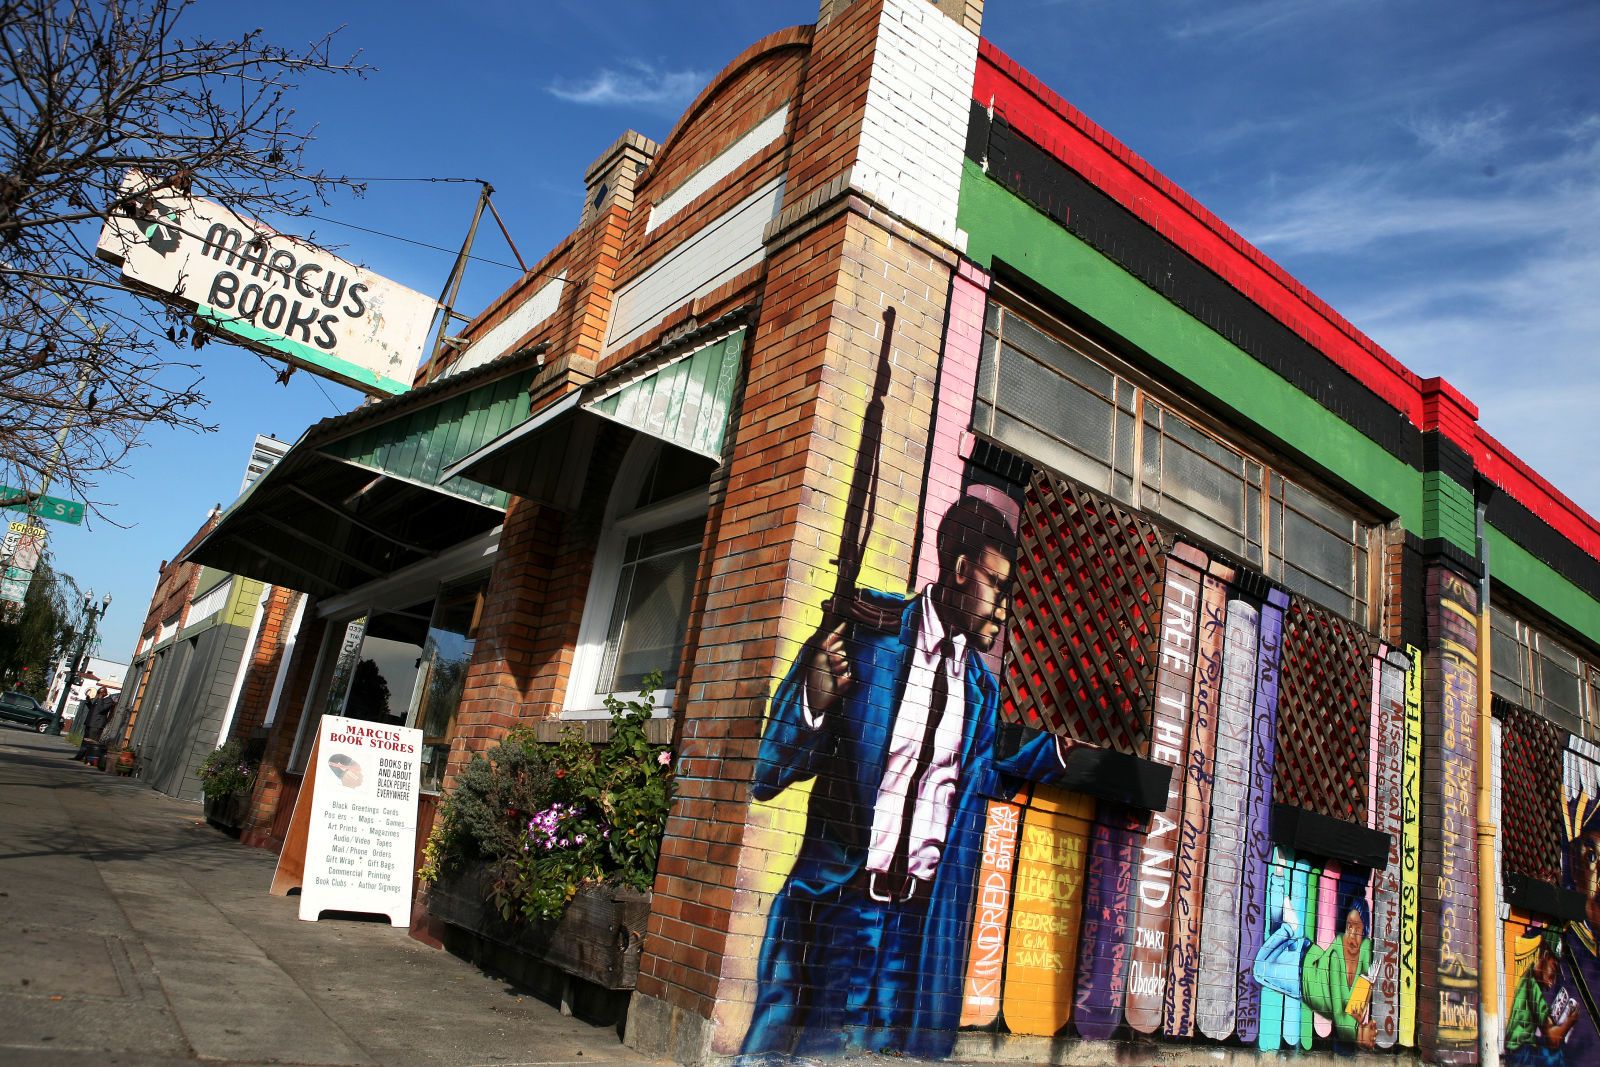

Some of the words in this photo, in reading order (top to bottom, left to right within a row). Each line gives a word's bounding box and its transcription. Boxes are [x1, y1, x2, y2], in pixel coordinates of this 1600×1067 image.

[201, 222, 369, 318] MARCUS
[207, 271, 340, 350] BOOKS
[10, 522, 45, 536] SCHOOL
[1163, 580, 1197, 673] FREE
[1204, 601, 1224, 639] A
[1223, 627, 1254, 743] KEEP
[1261, 635, 1278, 695] The
[1196, 647, 1221, 741] Piece
[1443, 671, 1458, 751] Were
[1460, 670, 1473, 752] Their
[330, 733, 363, 746] BOOK
[369, 738, 414, 754] STORES
[346, 725, 400, 741] MARCUS
[1154, 692, 1186, 767] THE
[1379, 712, 1389, 774] CARTER
[378, 768, 391, 778] AND
[392, 770, 412, 781] ABOUT
[379, 758, 402, 770] BOOKS
[404, 761, 412, 771] BY
[1188, 749, 1215, 800] of
[1252, 699, 1274, 817] Color
[1405, 698, 1418, 824] FAITH
[332, 801, 348, 810] Black
[352, 804, 379, 814] Greetings
[382, 807, 399, 816] Cards
[376, 790, 410, 801] EVERYWHERE
[377, 778, 393, 789] BLACK
[393, 780, 411, 792] PEOPLE
[1459, 760, 1473, 817] Eyes
[327, 823, 338, 831] Art
[339, 824, 357, 833] Prints
[369, 827, 400, 838] Magazines
[358, 815, 374, 825] Maps
[386, 819, 405, 828] Games
[376, 839, 392, 848] Tapes
[983, 806, 1009, 865] OCTAVIA
[996, 808, 1019, 871] BUTLER
[1437, 759, 1459, 900] Watching
[326, 855, 338, 864] Gift
[339, 857, 355, 867] Wrap
[367, 859, 380, 868] Gift
[380, 860, 395, 870] Bags
[372, 849, 392, 858] Orders
[1023, 825, 1081, 869] STOLEN
[1087, 825, 1110, 912] ELAINE
[1403, 832, 1415, 871] OF
[315, 877, 330, 886] Book
[331, 879, 347, 888] Clubs
[358, 881, 378, 891] Author
[378, 882, 401, 893] Signings
[328, 867, 363, 877] Commercial
[367, 871, 391, 881] Printing
[1018, 865, 1081, 908] LEGACY
[1115, 838, 1133, 913] TASTE
[1388, 872, 1398, 892] of
[967, 873, 1009, 1006] KINDRED
[1015, 911, 1069, 936] GEORGE
[1022, 933, 1049, 950] G.M.
[1135, 926, 1165, 950] IMARI
[1385, 897, 1398, 937] the
[1401, 885, 1415, 974] ACTS
[1440, 907, 1456, 968] God
[1015, 951, 1064, 974] JAMES
[1075, 919, 1098, 1014] BROWN
[1109, 943, 1126, 1015] POWER
[1129, 960, 1167, 1000] Obadele
[1164, 937, 1184, 1038] Cooper
[1178, 942, 1198, 1038] California
[1238, 967, 1251, 1040] WALKER
[1246, 981, 1260, 1028] ALICE
[1382, 940, 1398, 1038] Negro
[1438, 991, 1478, 1029] Hurston
